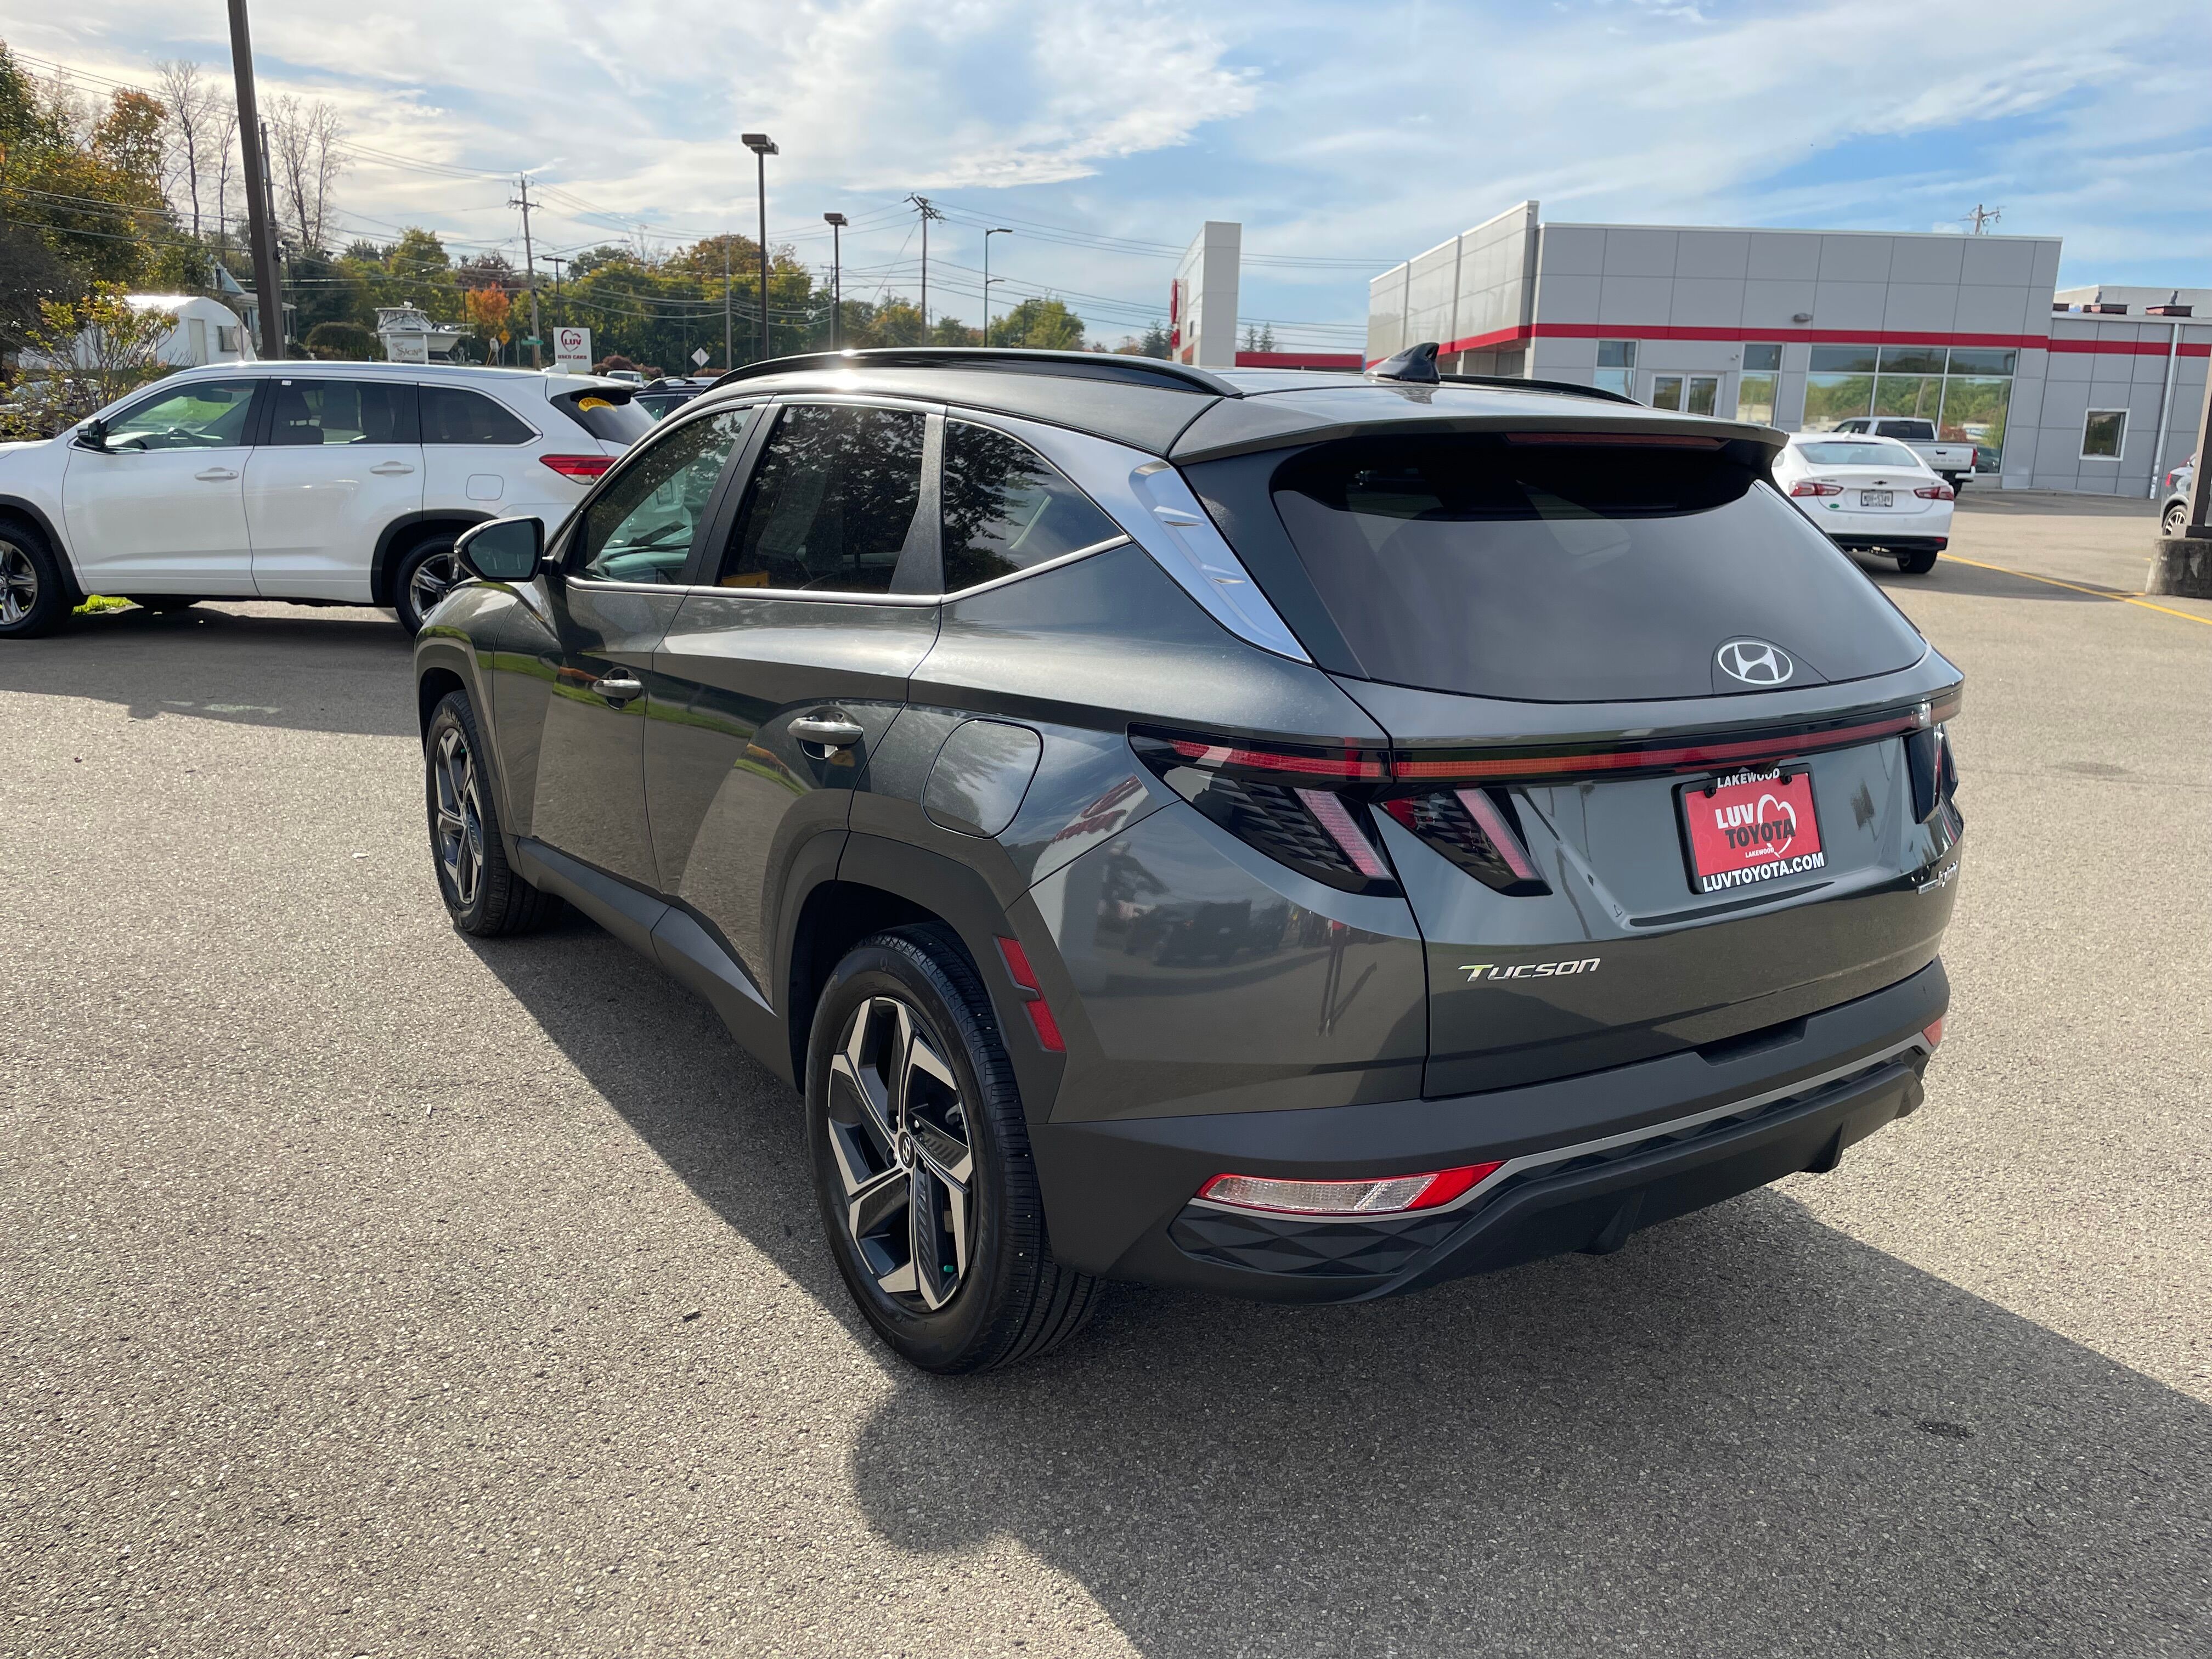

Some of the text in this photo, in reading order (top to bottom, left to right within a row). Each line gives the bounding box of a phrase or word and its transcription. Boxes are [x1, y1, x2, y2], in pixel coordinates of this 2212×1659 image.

[1715, 803, 1754, 829] LUV
[1725, 819, 1796, 849] TOYOTA
[1745, 847, 1775, 858] LAKEWOOD
[1702, 853, 1825, 892] LUVTOYOTA.COM
